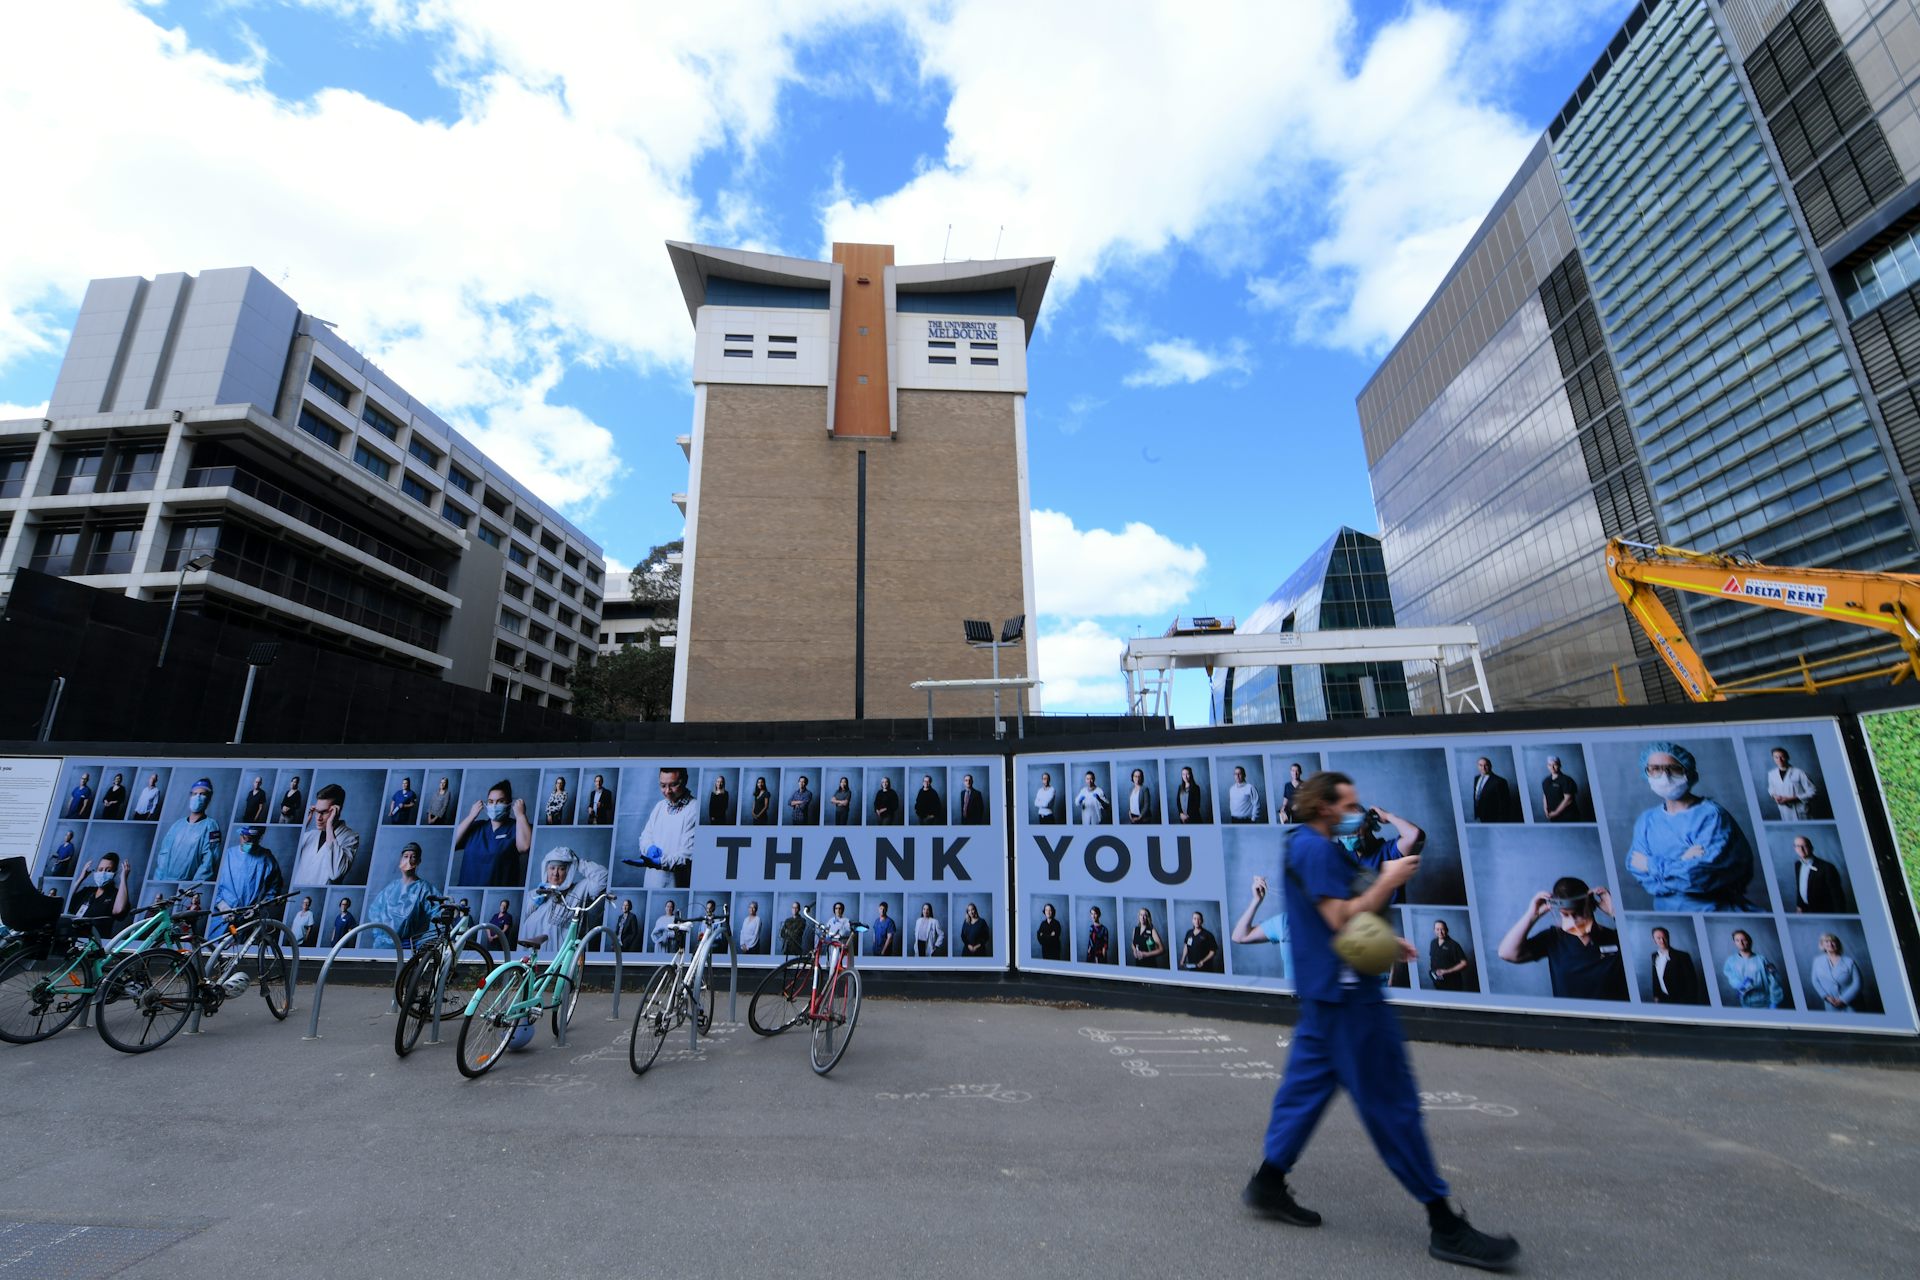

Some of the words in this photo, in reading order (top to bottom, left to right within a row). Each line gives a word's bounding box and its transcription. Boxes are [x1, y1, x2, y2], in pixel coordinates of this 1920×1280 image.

[928, 320, 942, 328] THE
[944, 321, 986, 330] UNIVERSITY
[987, 322, 997, 330] OF
[928, 327, 998, 341] MELBOURNE
[1745, 585, 1782, 599] DELTA
[1787, 590, 1825, 604] RENT
[716, 836, 972, 880] THANK
[1033, 835, 1192, 885] YOU
